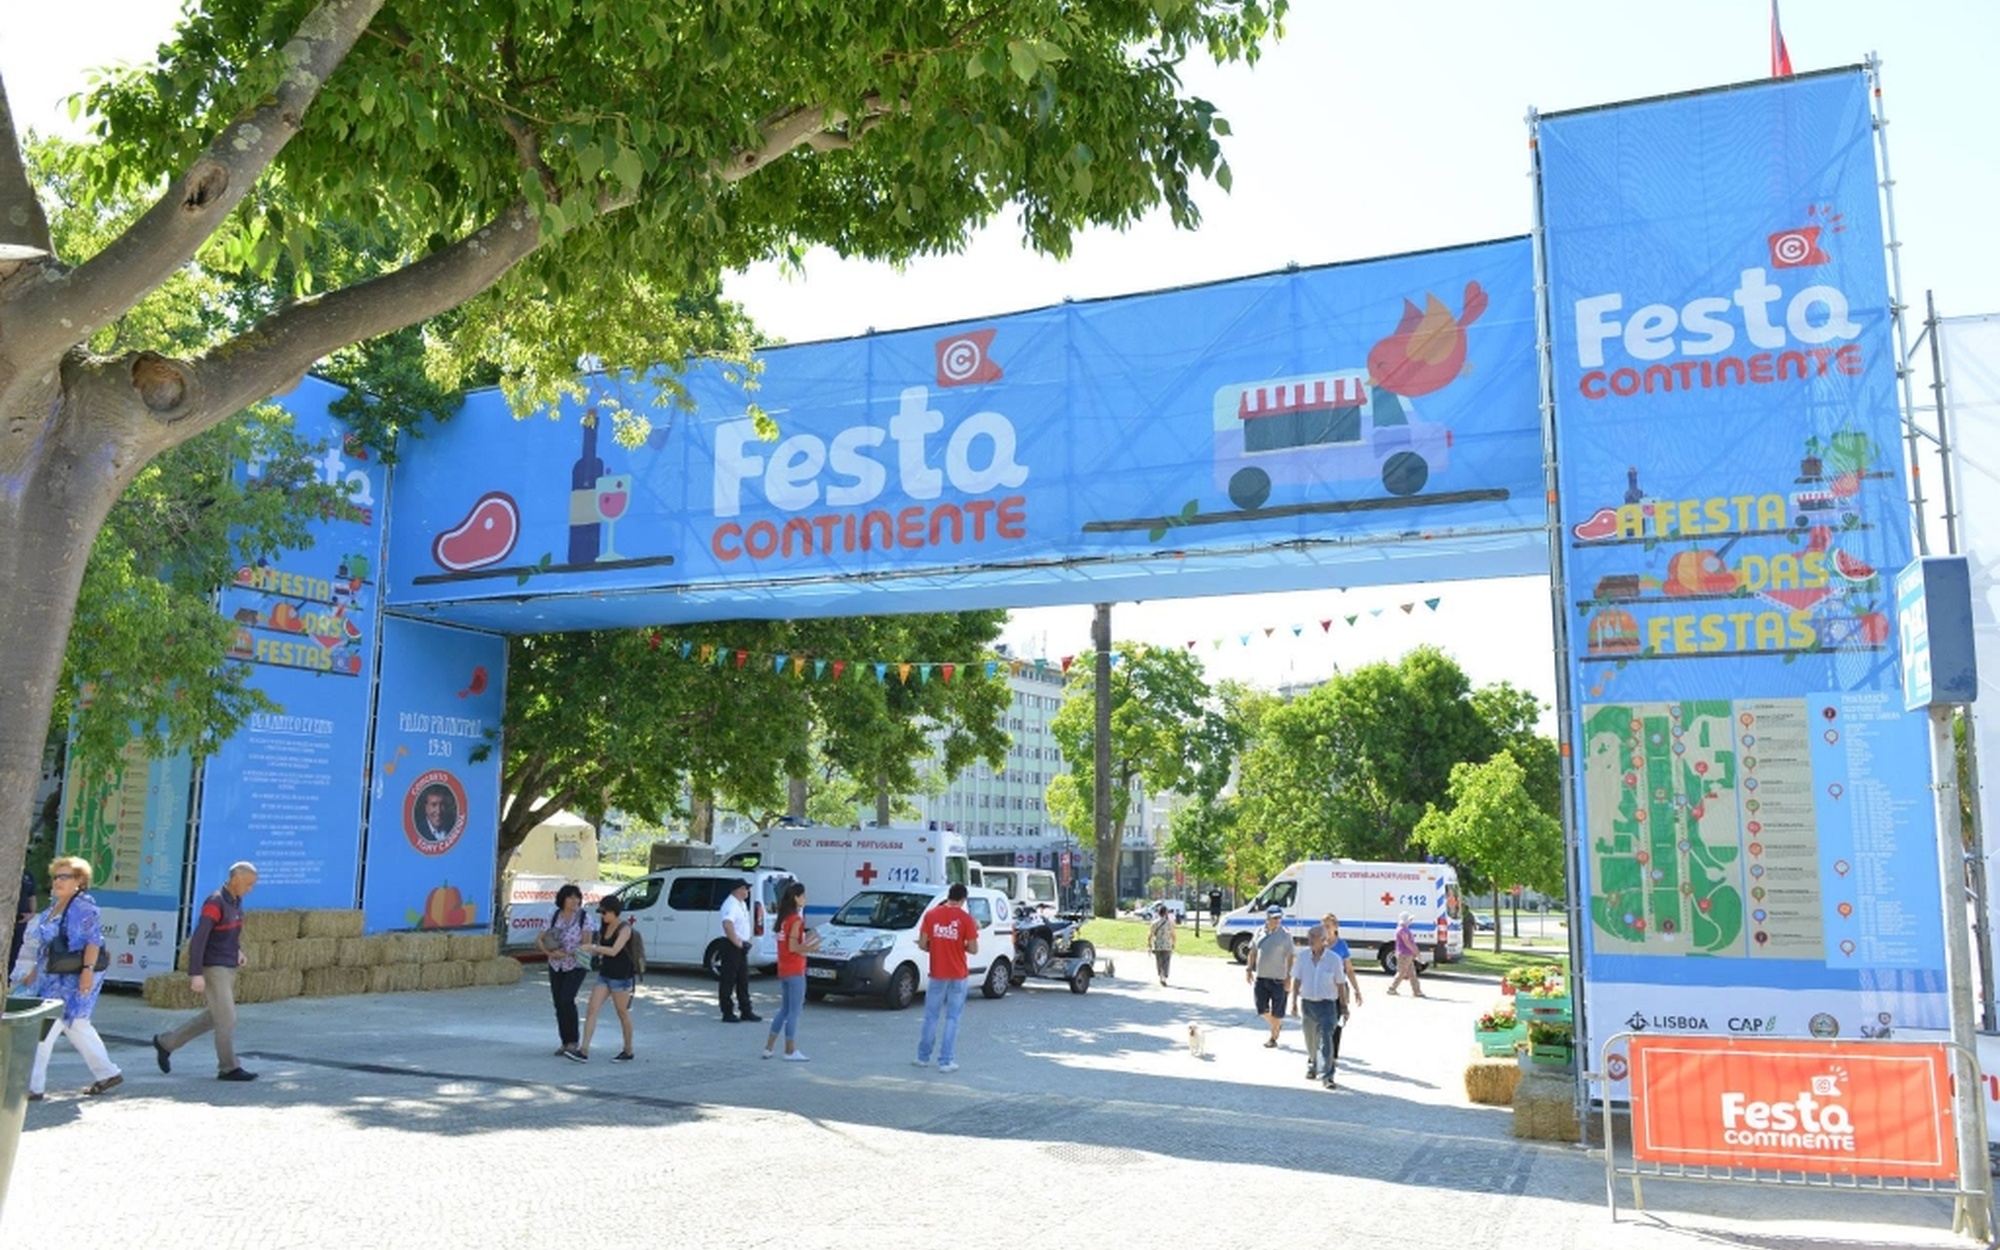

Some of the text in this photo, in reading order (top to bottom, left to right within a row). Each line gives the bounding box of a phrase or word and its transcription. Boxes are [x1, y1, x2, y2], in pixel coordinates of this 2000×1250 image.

[1575, 267, 1862, 368] Festa
[1580, 344, 1864, 399] CONTINENTE
[714, 386, 1029, 517] Festa
[712, 496, 1027, 561] CONTINENTE
[1617, 494, 1786, 538] A FESTA
[268, 571, 329, 600] FESTA
[1741, 550, 1829, 590] DAS
[1648, 610, 1816, 655] FESTAS
[257, 639, 333, 671] FESTAS
[895, 867, 919, 883] 112
[1408, 894, 1427, 906] 112
[1653, 1015, 1709, 1030] LISBOA
[1727, 1017, 1763, 1032] CAP
[1721, 1092, 1854, 1134] Festa
[1723, 1130, 1855, 1151] CONTINENTE
